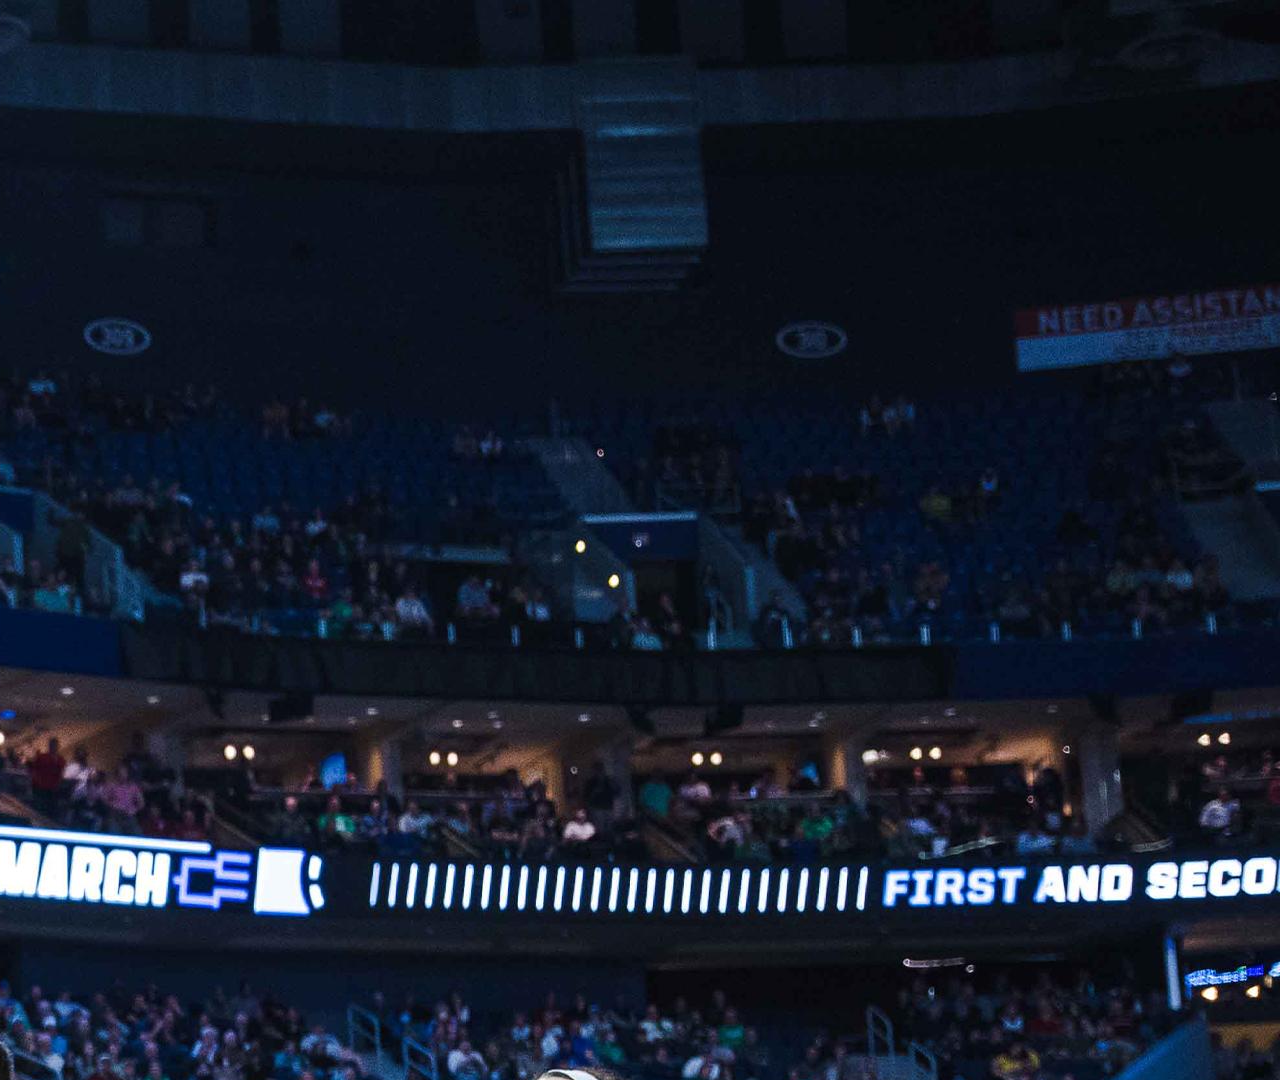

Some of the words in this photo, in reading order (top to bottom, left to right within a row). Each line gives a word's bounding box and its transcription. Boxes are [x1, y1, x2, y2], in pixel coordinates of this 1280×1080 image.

[1039, 301, 1124, 335] NEED
[882, 866, 1027, 908] FIRST
[1032, 862, 1134, 904] AND
[1144, 855, 1280, 901] SECO
